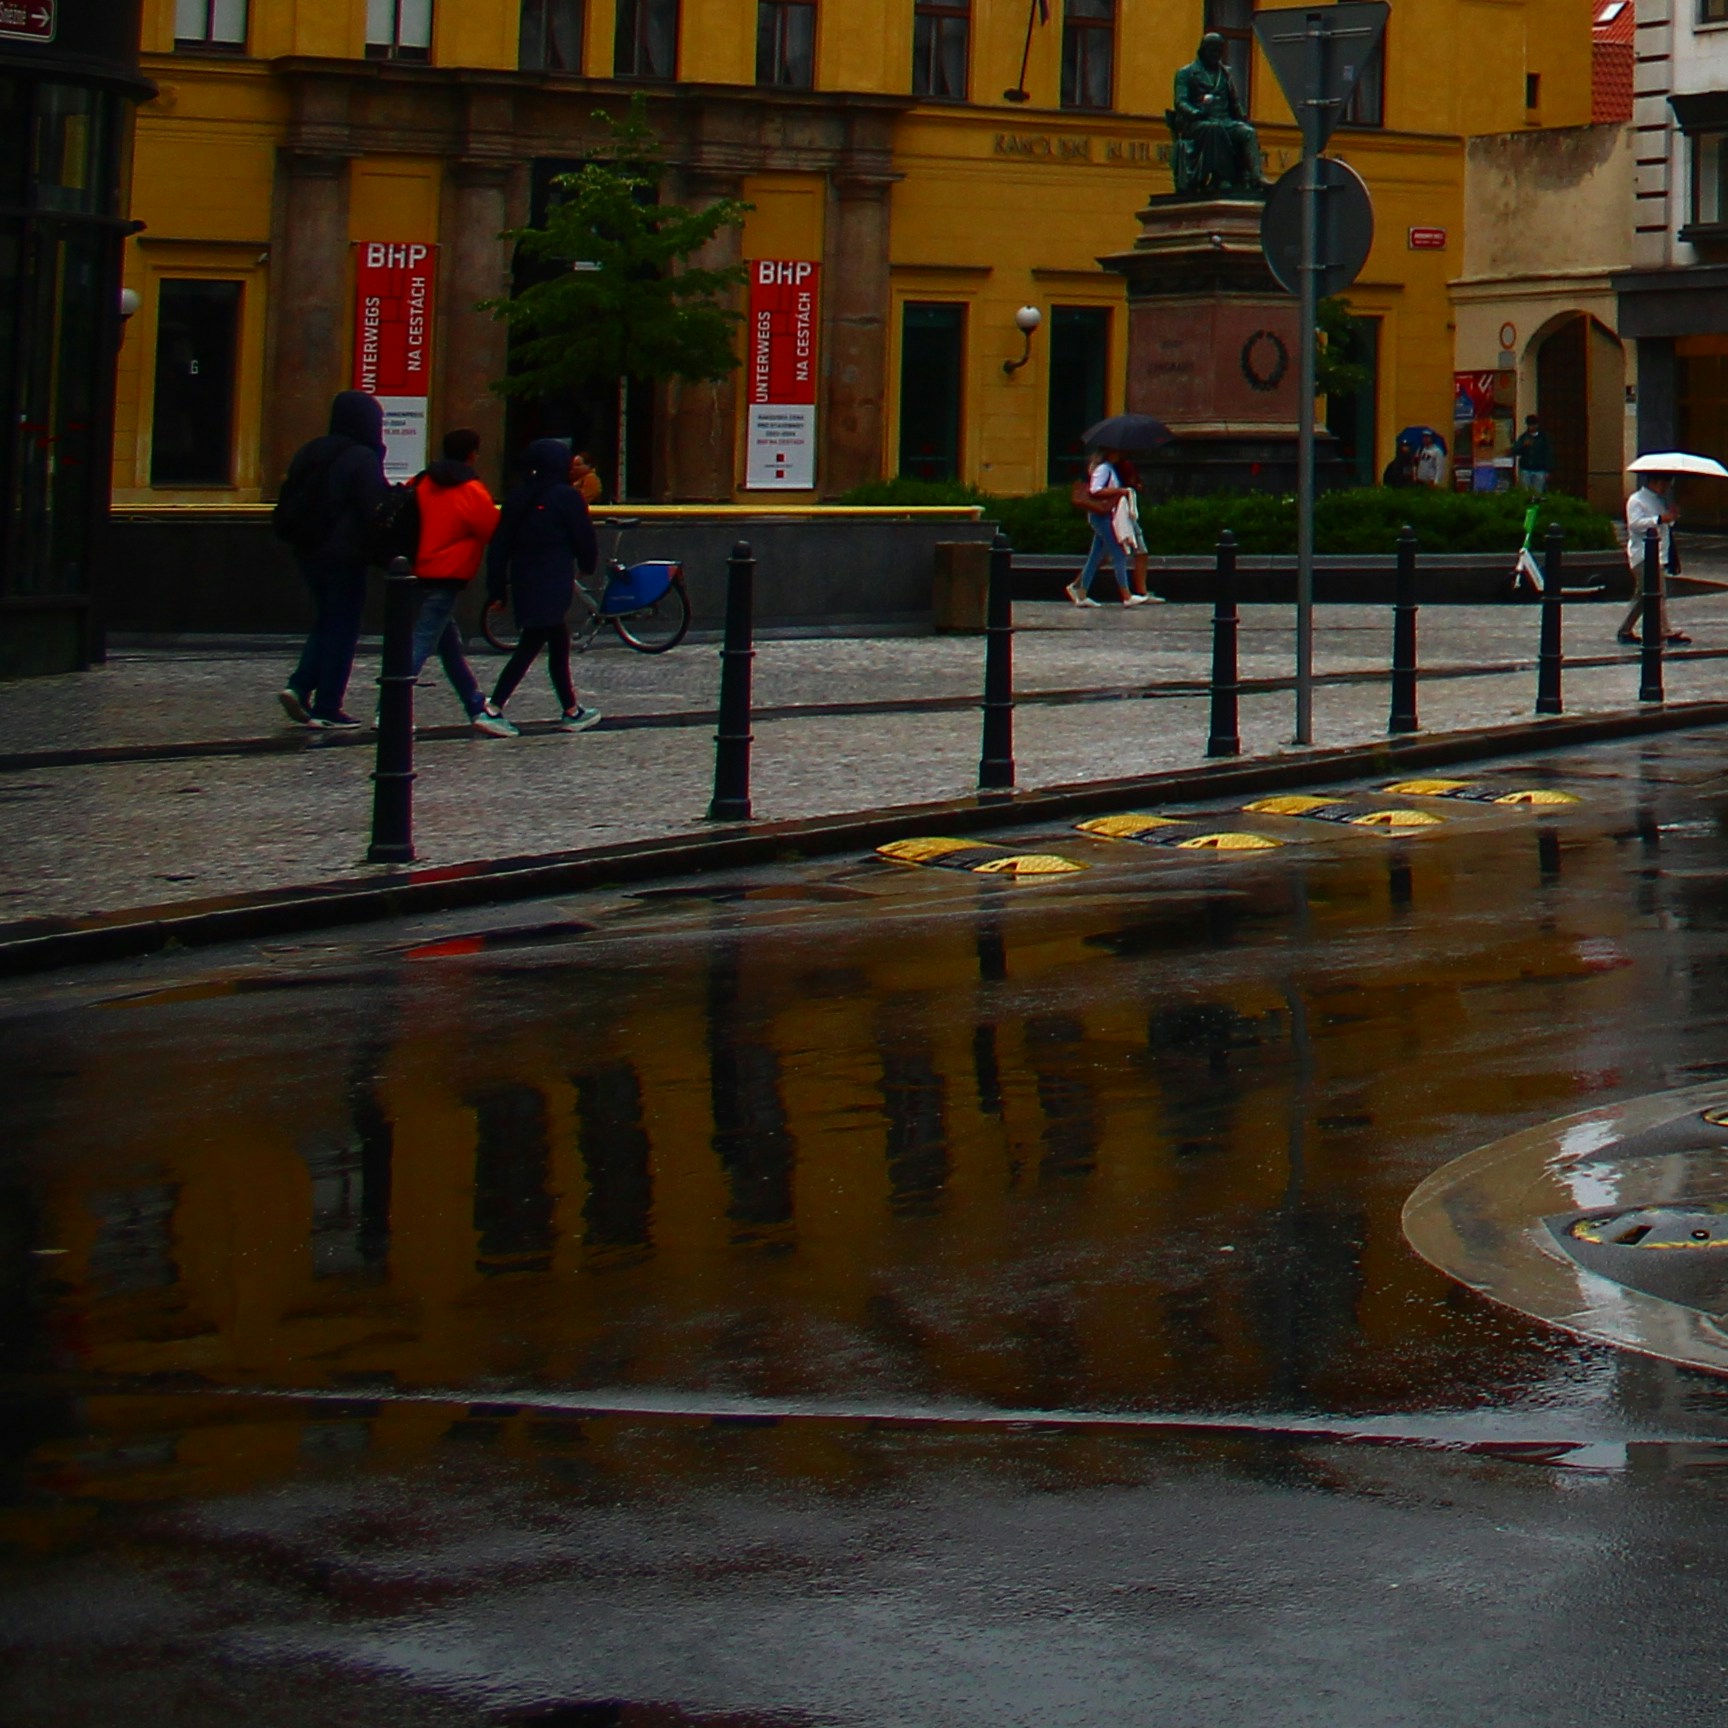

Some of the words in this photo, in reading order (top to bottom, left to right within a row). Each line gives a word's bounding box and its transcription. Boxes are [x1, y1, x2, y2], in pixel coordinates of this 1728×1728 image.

[408, 276, 426, 346] CESTÁCH
[795, 292, 811, 357] CESTÁCH
[361, 296, 381, 395] UNTERWEGS
[407, 349, 422, 371] NA
[755, 311, 772, 403] UNTERWEGS
[796, 361, 809, 381] NA
